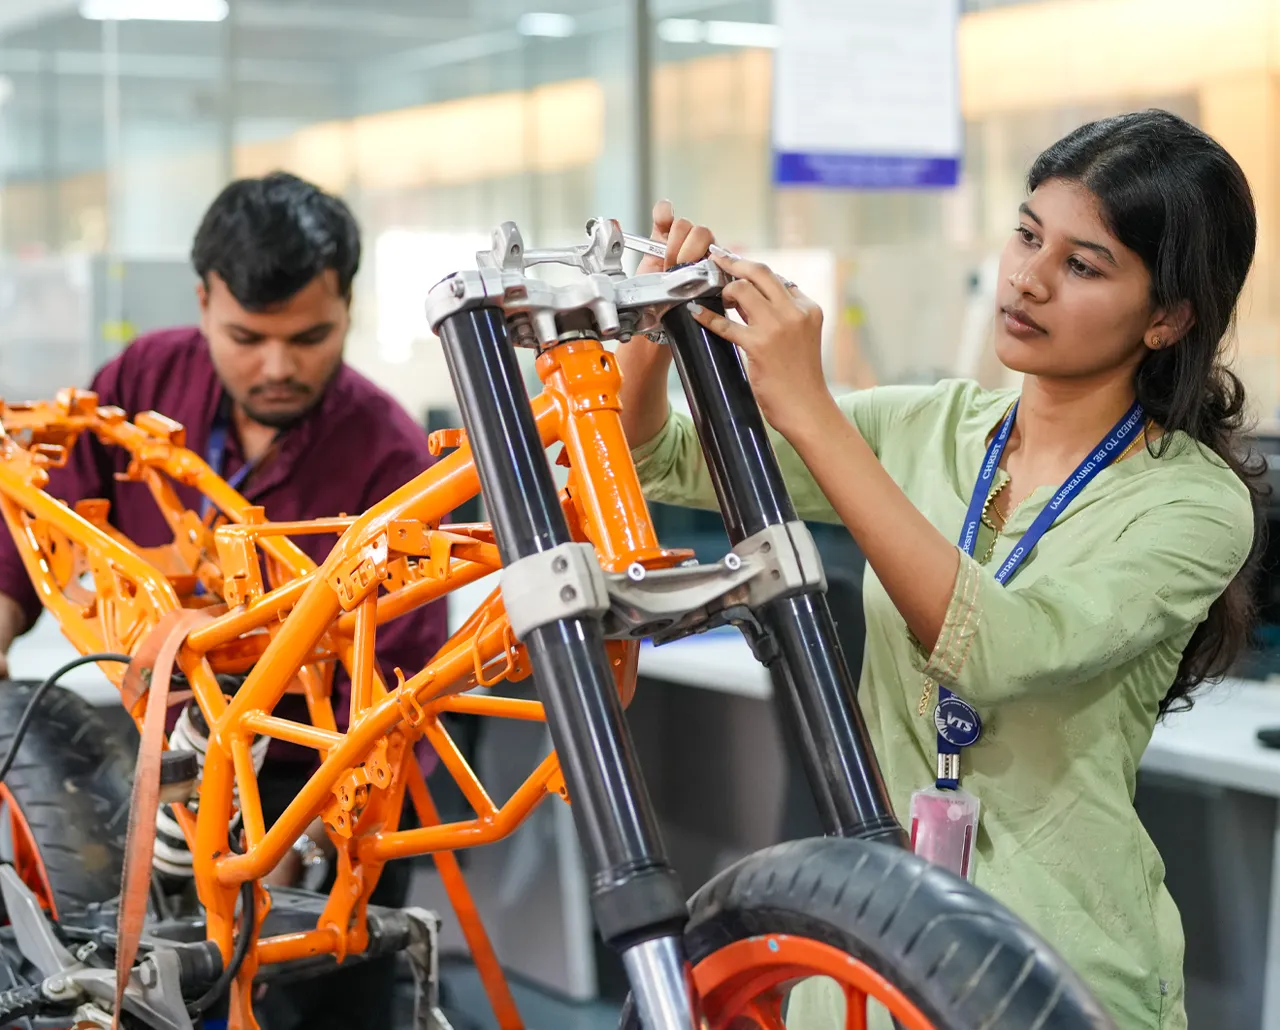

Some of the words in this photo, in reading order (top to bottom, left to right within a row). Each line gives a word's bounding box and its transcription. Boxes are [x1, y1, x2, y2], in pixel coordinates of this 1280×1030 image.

[1093, 449, 1107, 463] BE
[1105, 438, 1119, 451] TO
[982, 443, 1001, 480] CHRIST
[1049, 461, 1096, 510] UNIVERSITY)
[996, 546, 1024, 583] CHRIST
[947, 711, 973, 732] VTS
